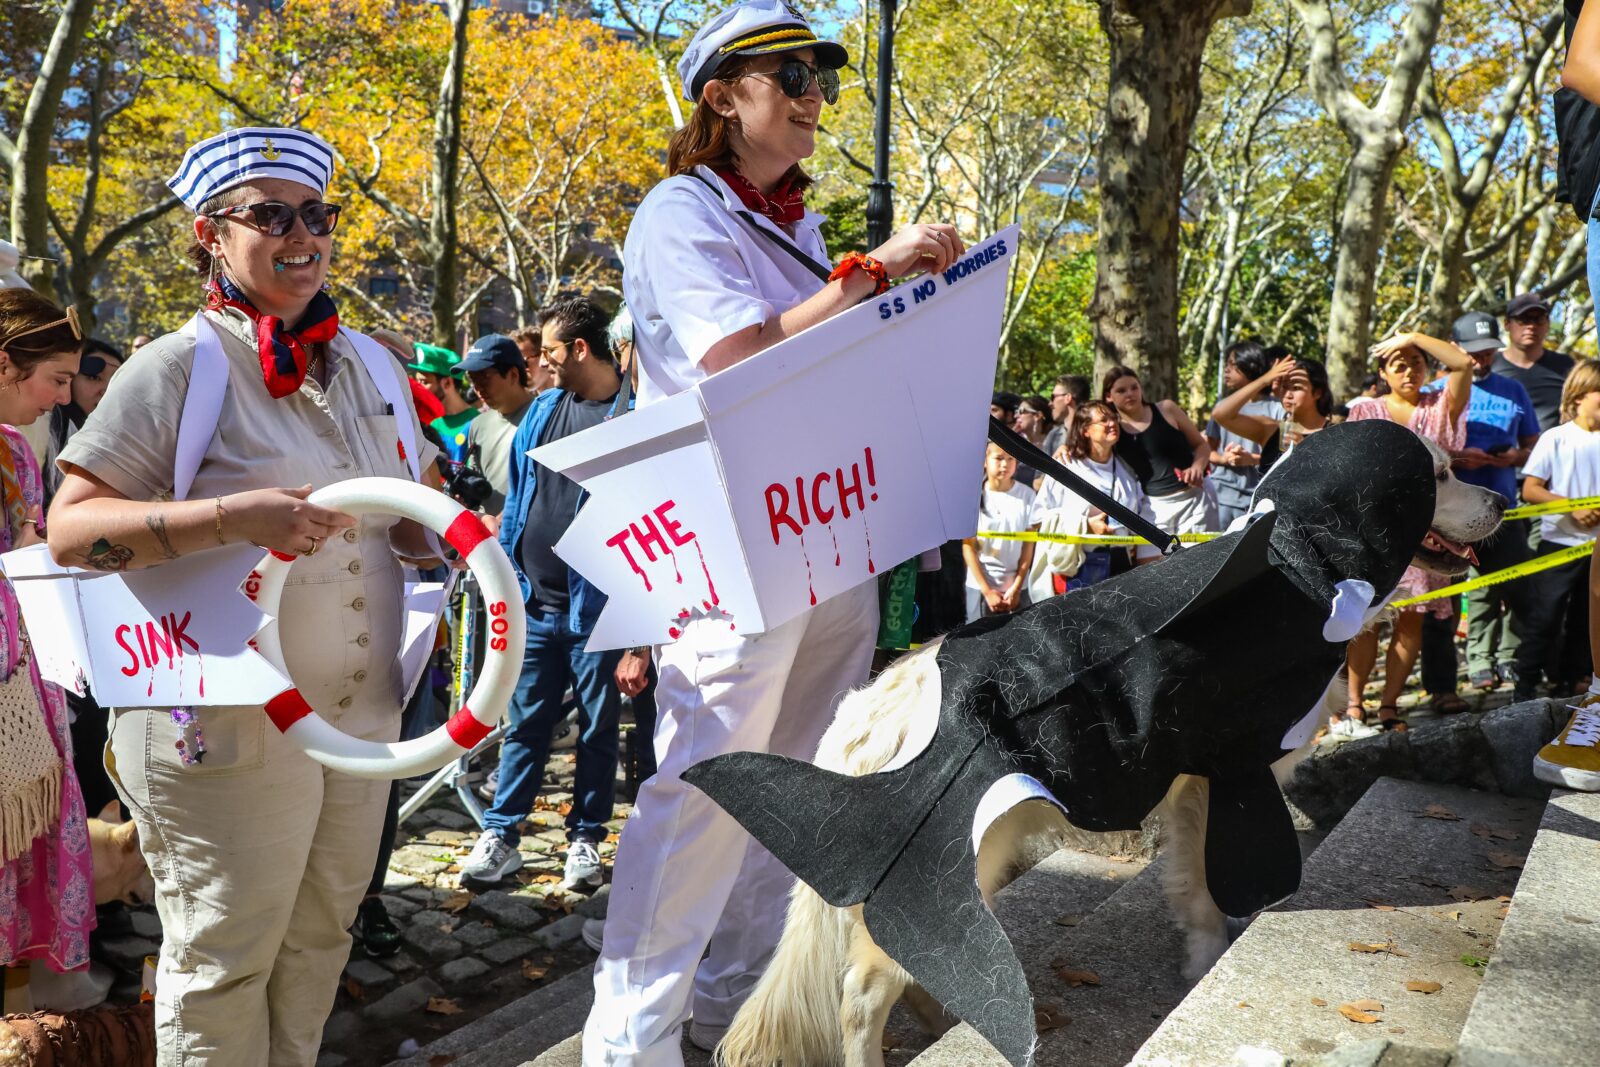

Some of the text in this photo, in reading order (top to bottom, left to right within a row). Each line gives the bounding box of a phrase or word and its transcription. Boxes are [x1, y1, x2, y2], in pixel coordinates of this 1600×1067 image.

[912, 279, 937, 304] NO
[942, 239, 1008, 286] WORRIES
[606, 446, 879, 575] THE RICH!
[489, 601, 509, 652] SOS
[886, 567, 909, 632] earth
[114, 610, 200, 677] SINK
